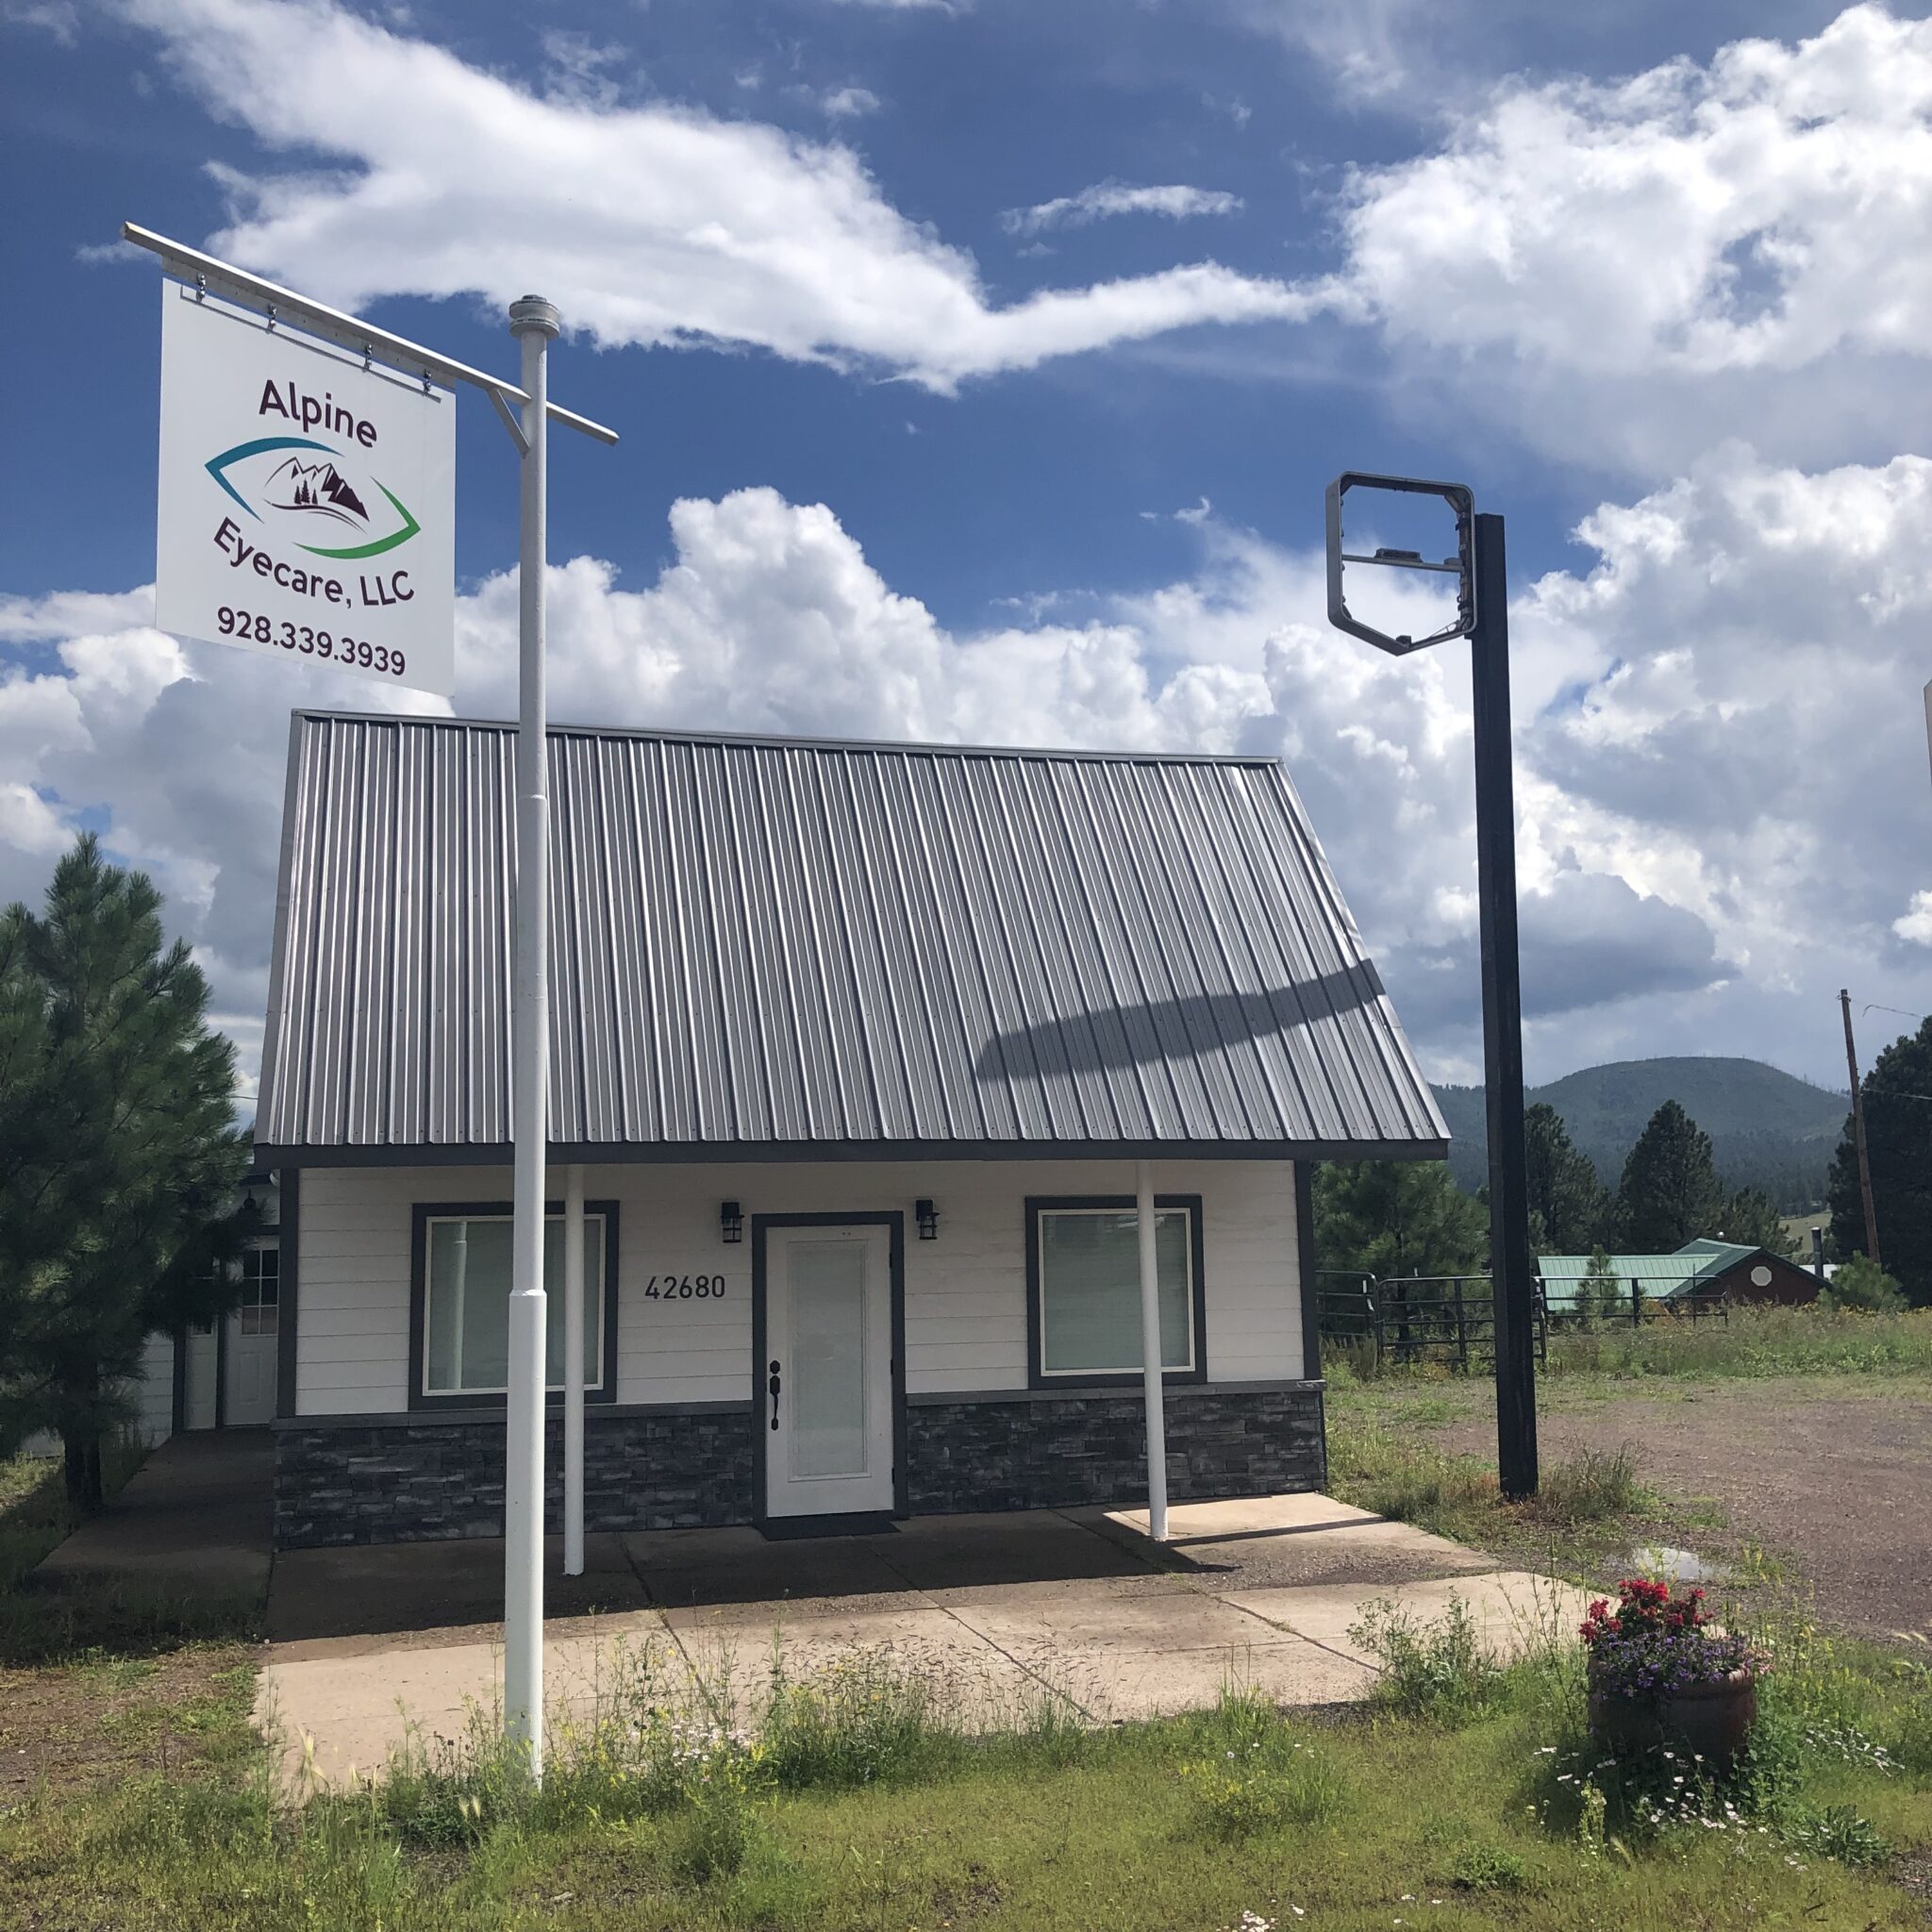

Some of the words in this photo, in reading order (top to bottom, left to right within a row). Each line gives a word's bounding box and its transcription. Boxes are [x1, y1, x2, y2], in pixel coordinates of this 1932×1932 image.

[258, 379, 377, 448] Alpine
[213, 517, 352, 608] Eyecare,
[359, 571, 415, 607] LLC
[217, 606, 407, 676] 928.339.3939
[644, 1274, 725, 1300] 42680
